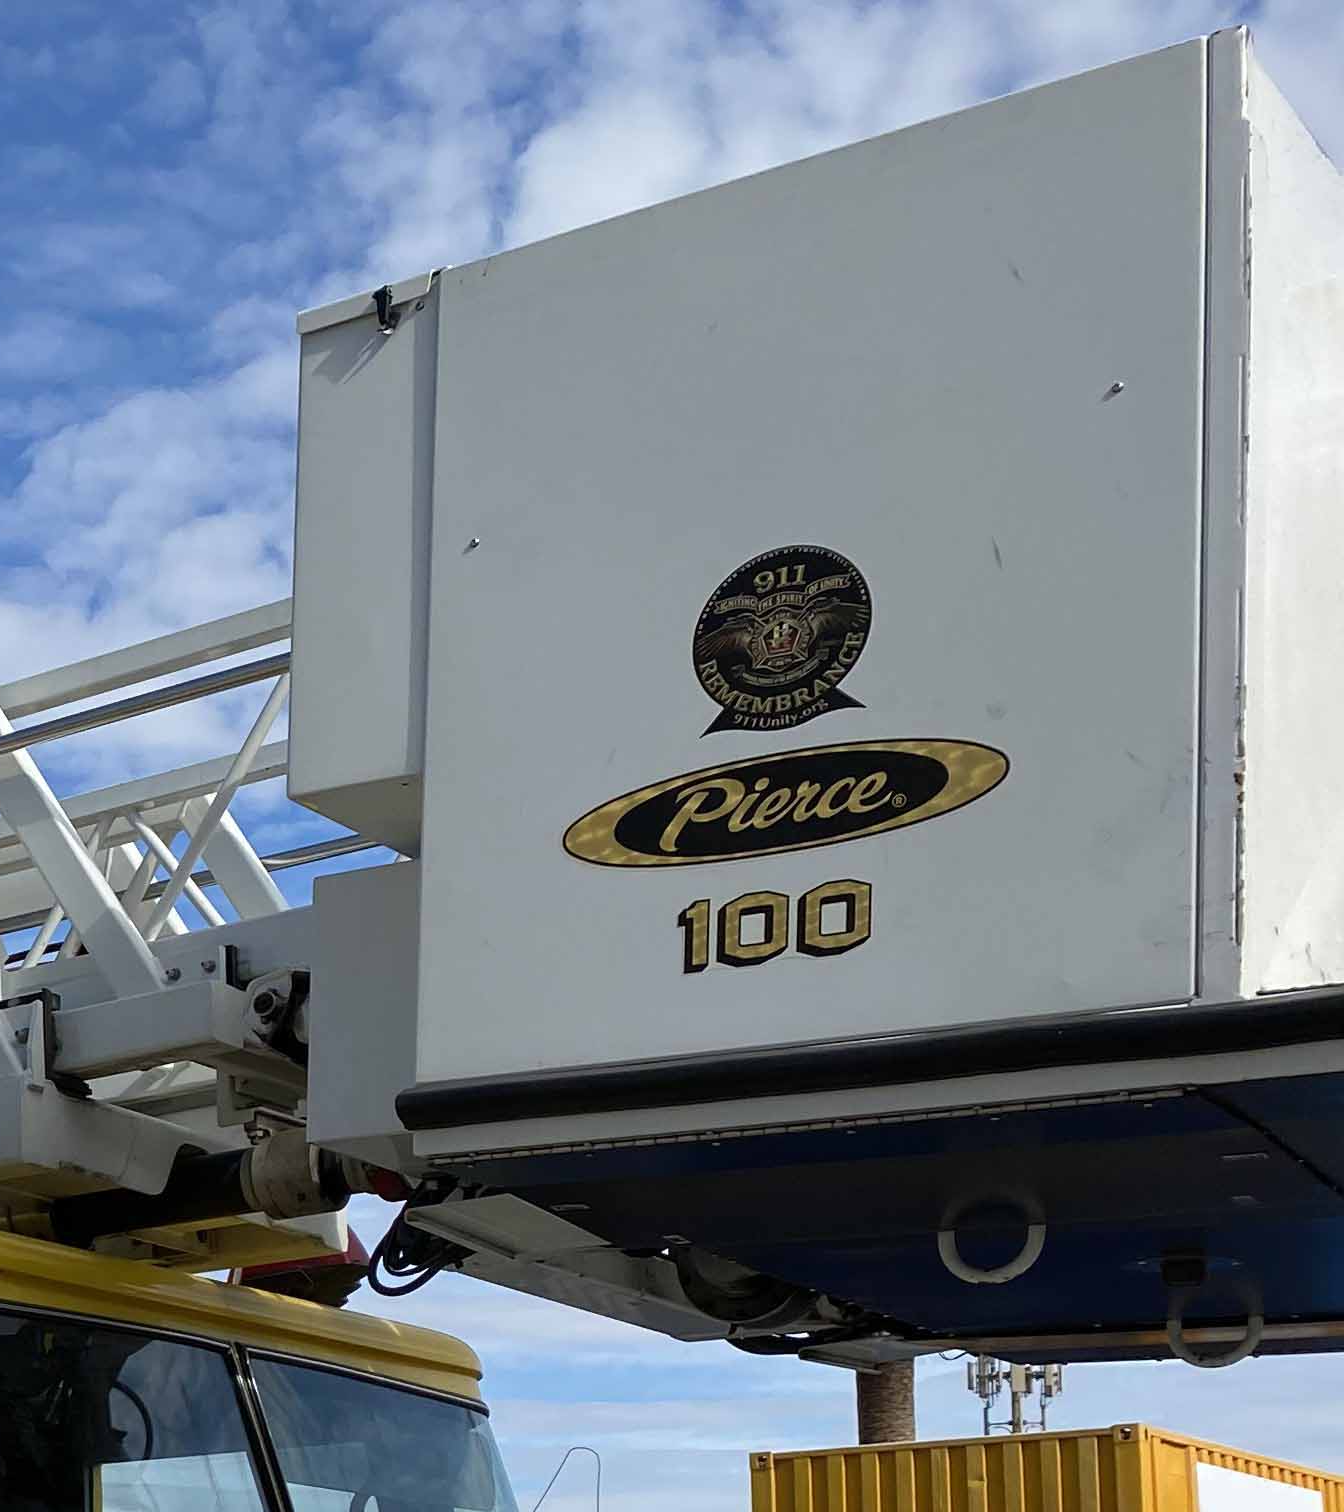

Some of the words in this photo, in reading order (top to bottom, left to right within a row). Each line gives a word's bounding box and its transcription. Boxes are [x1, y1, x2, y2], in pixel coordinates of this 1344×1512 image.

[753, 564, 806, 593] 911
[700, 632, 864, 713] REMEMBRANCE
[659, 771, 893, 852] Pierce
[677, 879, 872, 973] 100
